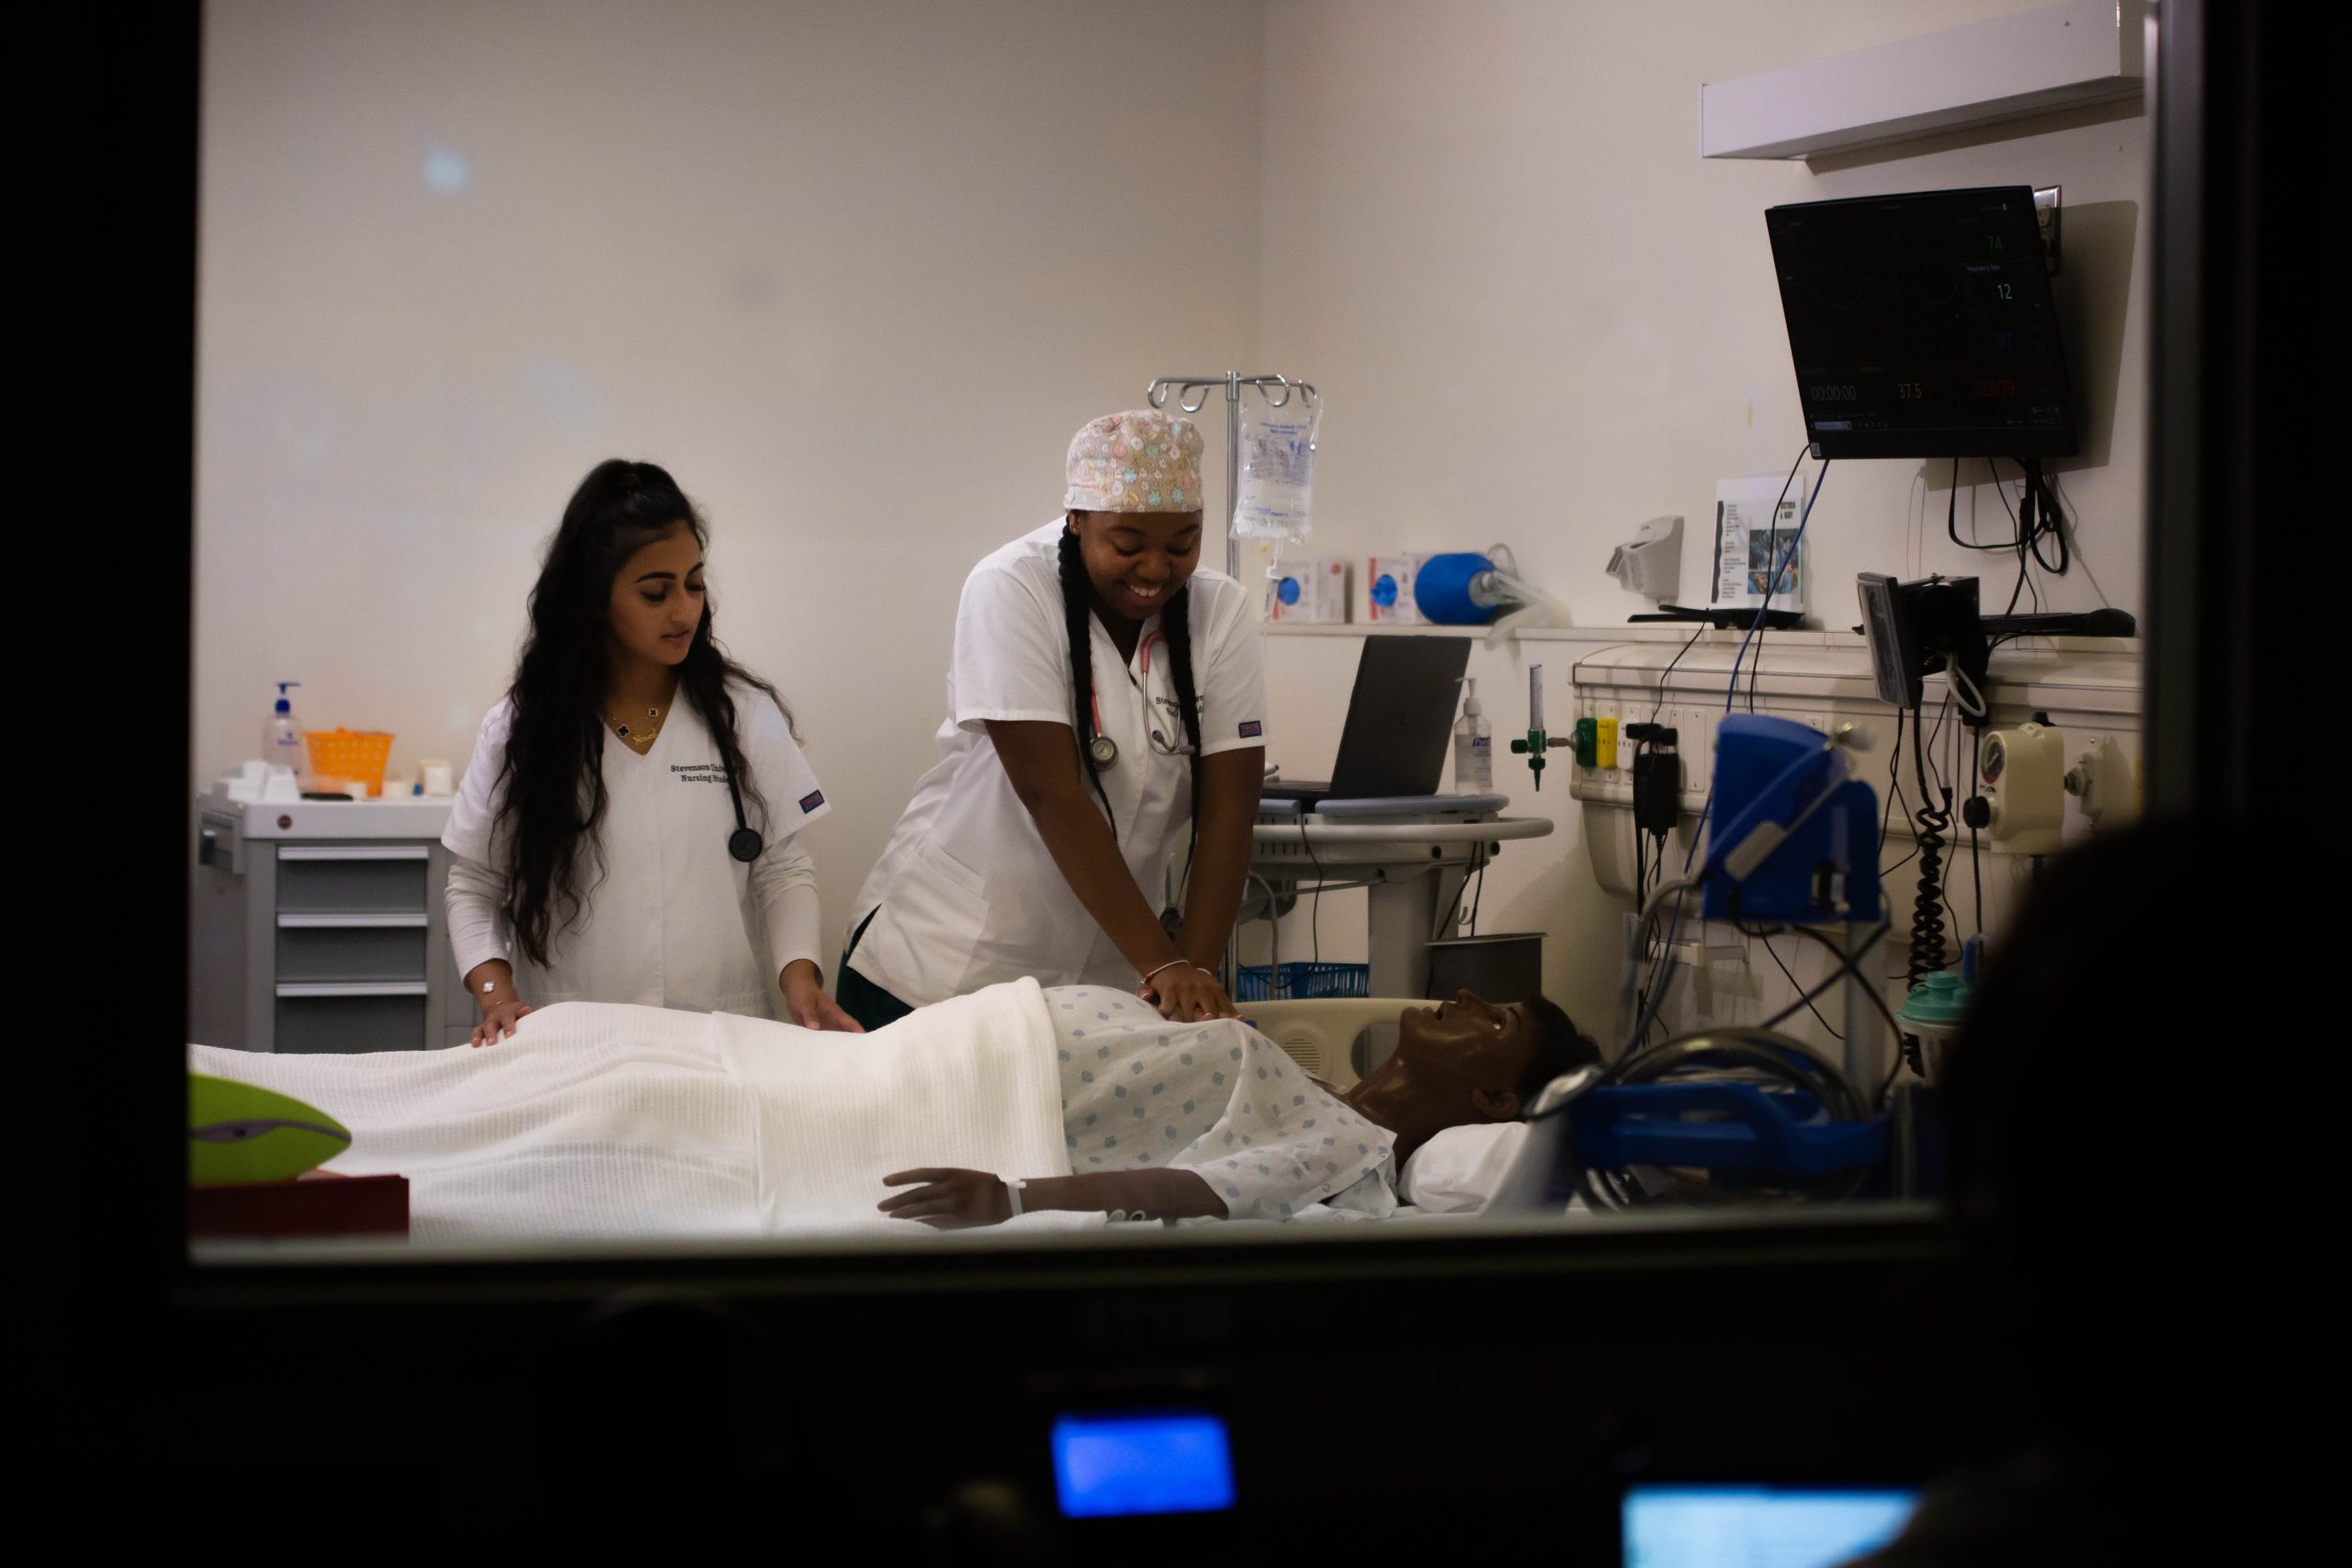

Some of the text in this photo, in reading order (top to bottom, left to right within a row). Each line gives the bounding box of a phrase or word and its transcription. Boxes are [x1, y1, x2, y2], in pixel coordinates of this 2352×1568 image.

[1986, 235, 2005, 251] 74
[1996, 283, 2014, 299] 12
[1810, 385, 1858, 401] 00:00:00
[1897, 382, 1923, 400] 37.5
[681, 773, 712, 784] Nursing
